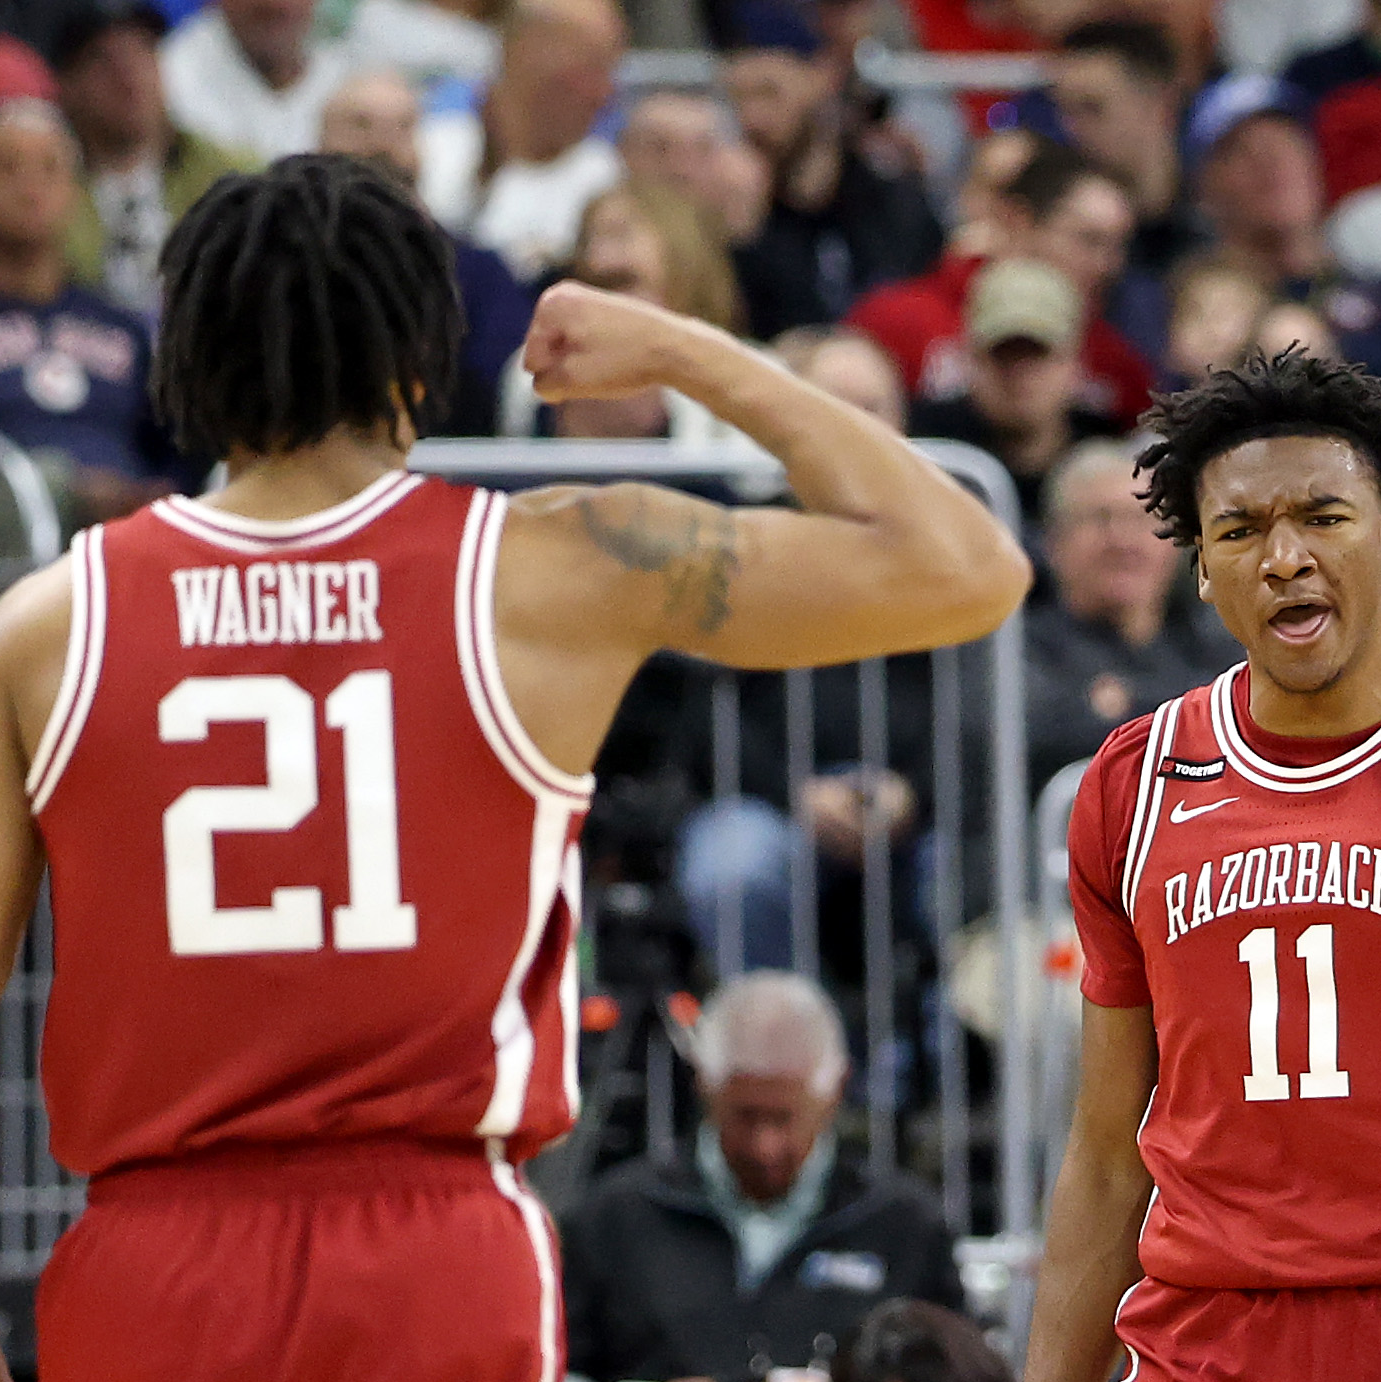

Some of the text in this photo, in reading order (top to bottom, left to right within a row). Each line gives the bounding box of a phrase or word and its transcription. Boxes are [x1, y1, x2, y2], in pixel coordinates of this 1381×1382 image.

[171, 559, 384, 648] WAGNER
[158, 668, 417, 956] 21
[1238, 923, 1350, 1102] 11
